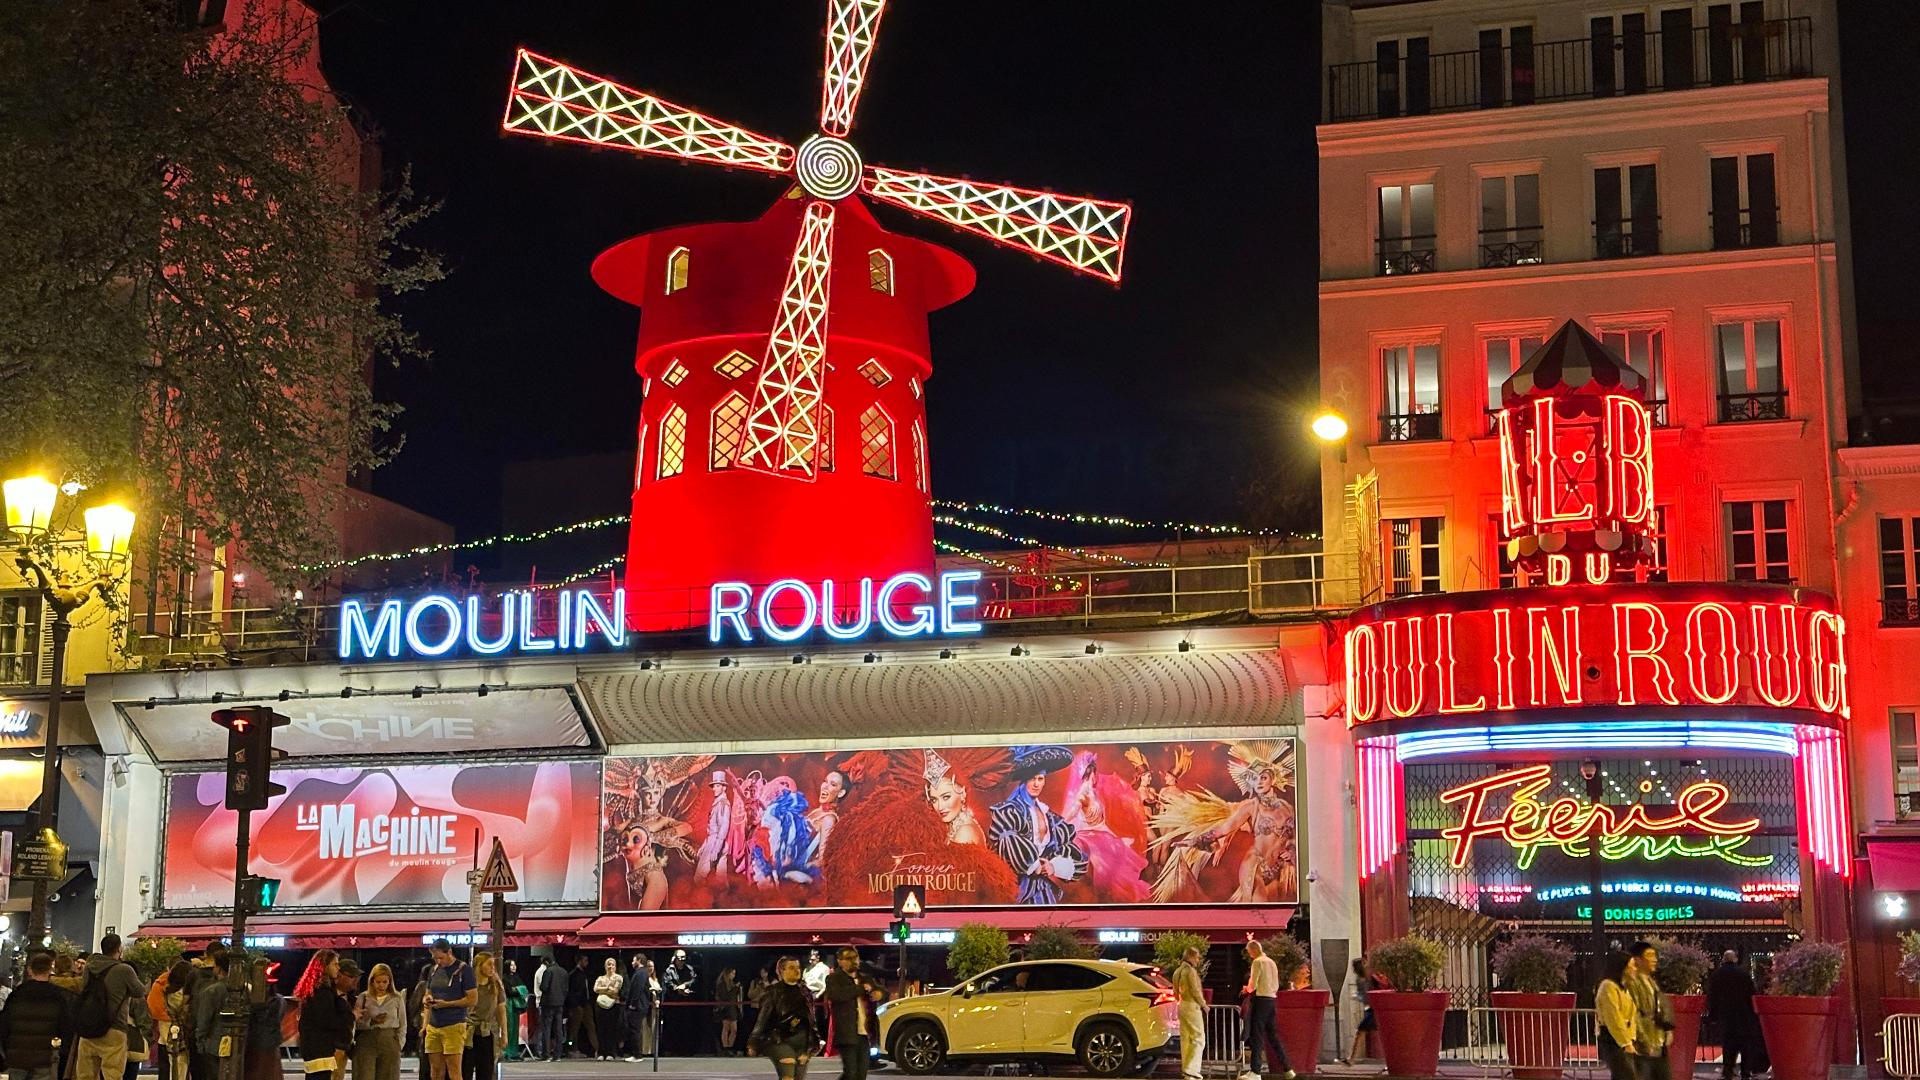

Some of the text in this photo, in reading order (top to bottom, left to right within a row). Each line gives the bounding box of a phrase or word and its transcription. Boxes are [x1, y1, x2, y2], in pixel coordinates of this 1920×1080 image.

[1548, 553, 1610, 585] DU
[339, 571, 982, 659] MOULIN ROUGE
[1345, 606, 1582, 729] OULIN
[1440, 765, 1760, 869] Féerie
[297, 804, 458, 859] LA MACHINE
[389, 858, 456, 867] du moulin rouge
[884, 852, 955, 875] Forever
[925, 871, 976, 892] ROUGE
[1604, 908, 1652, 920] DORISS
[678, 934, 714, 945] MOULIN
